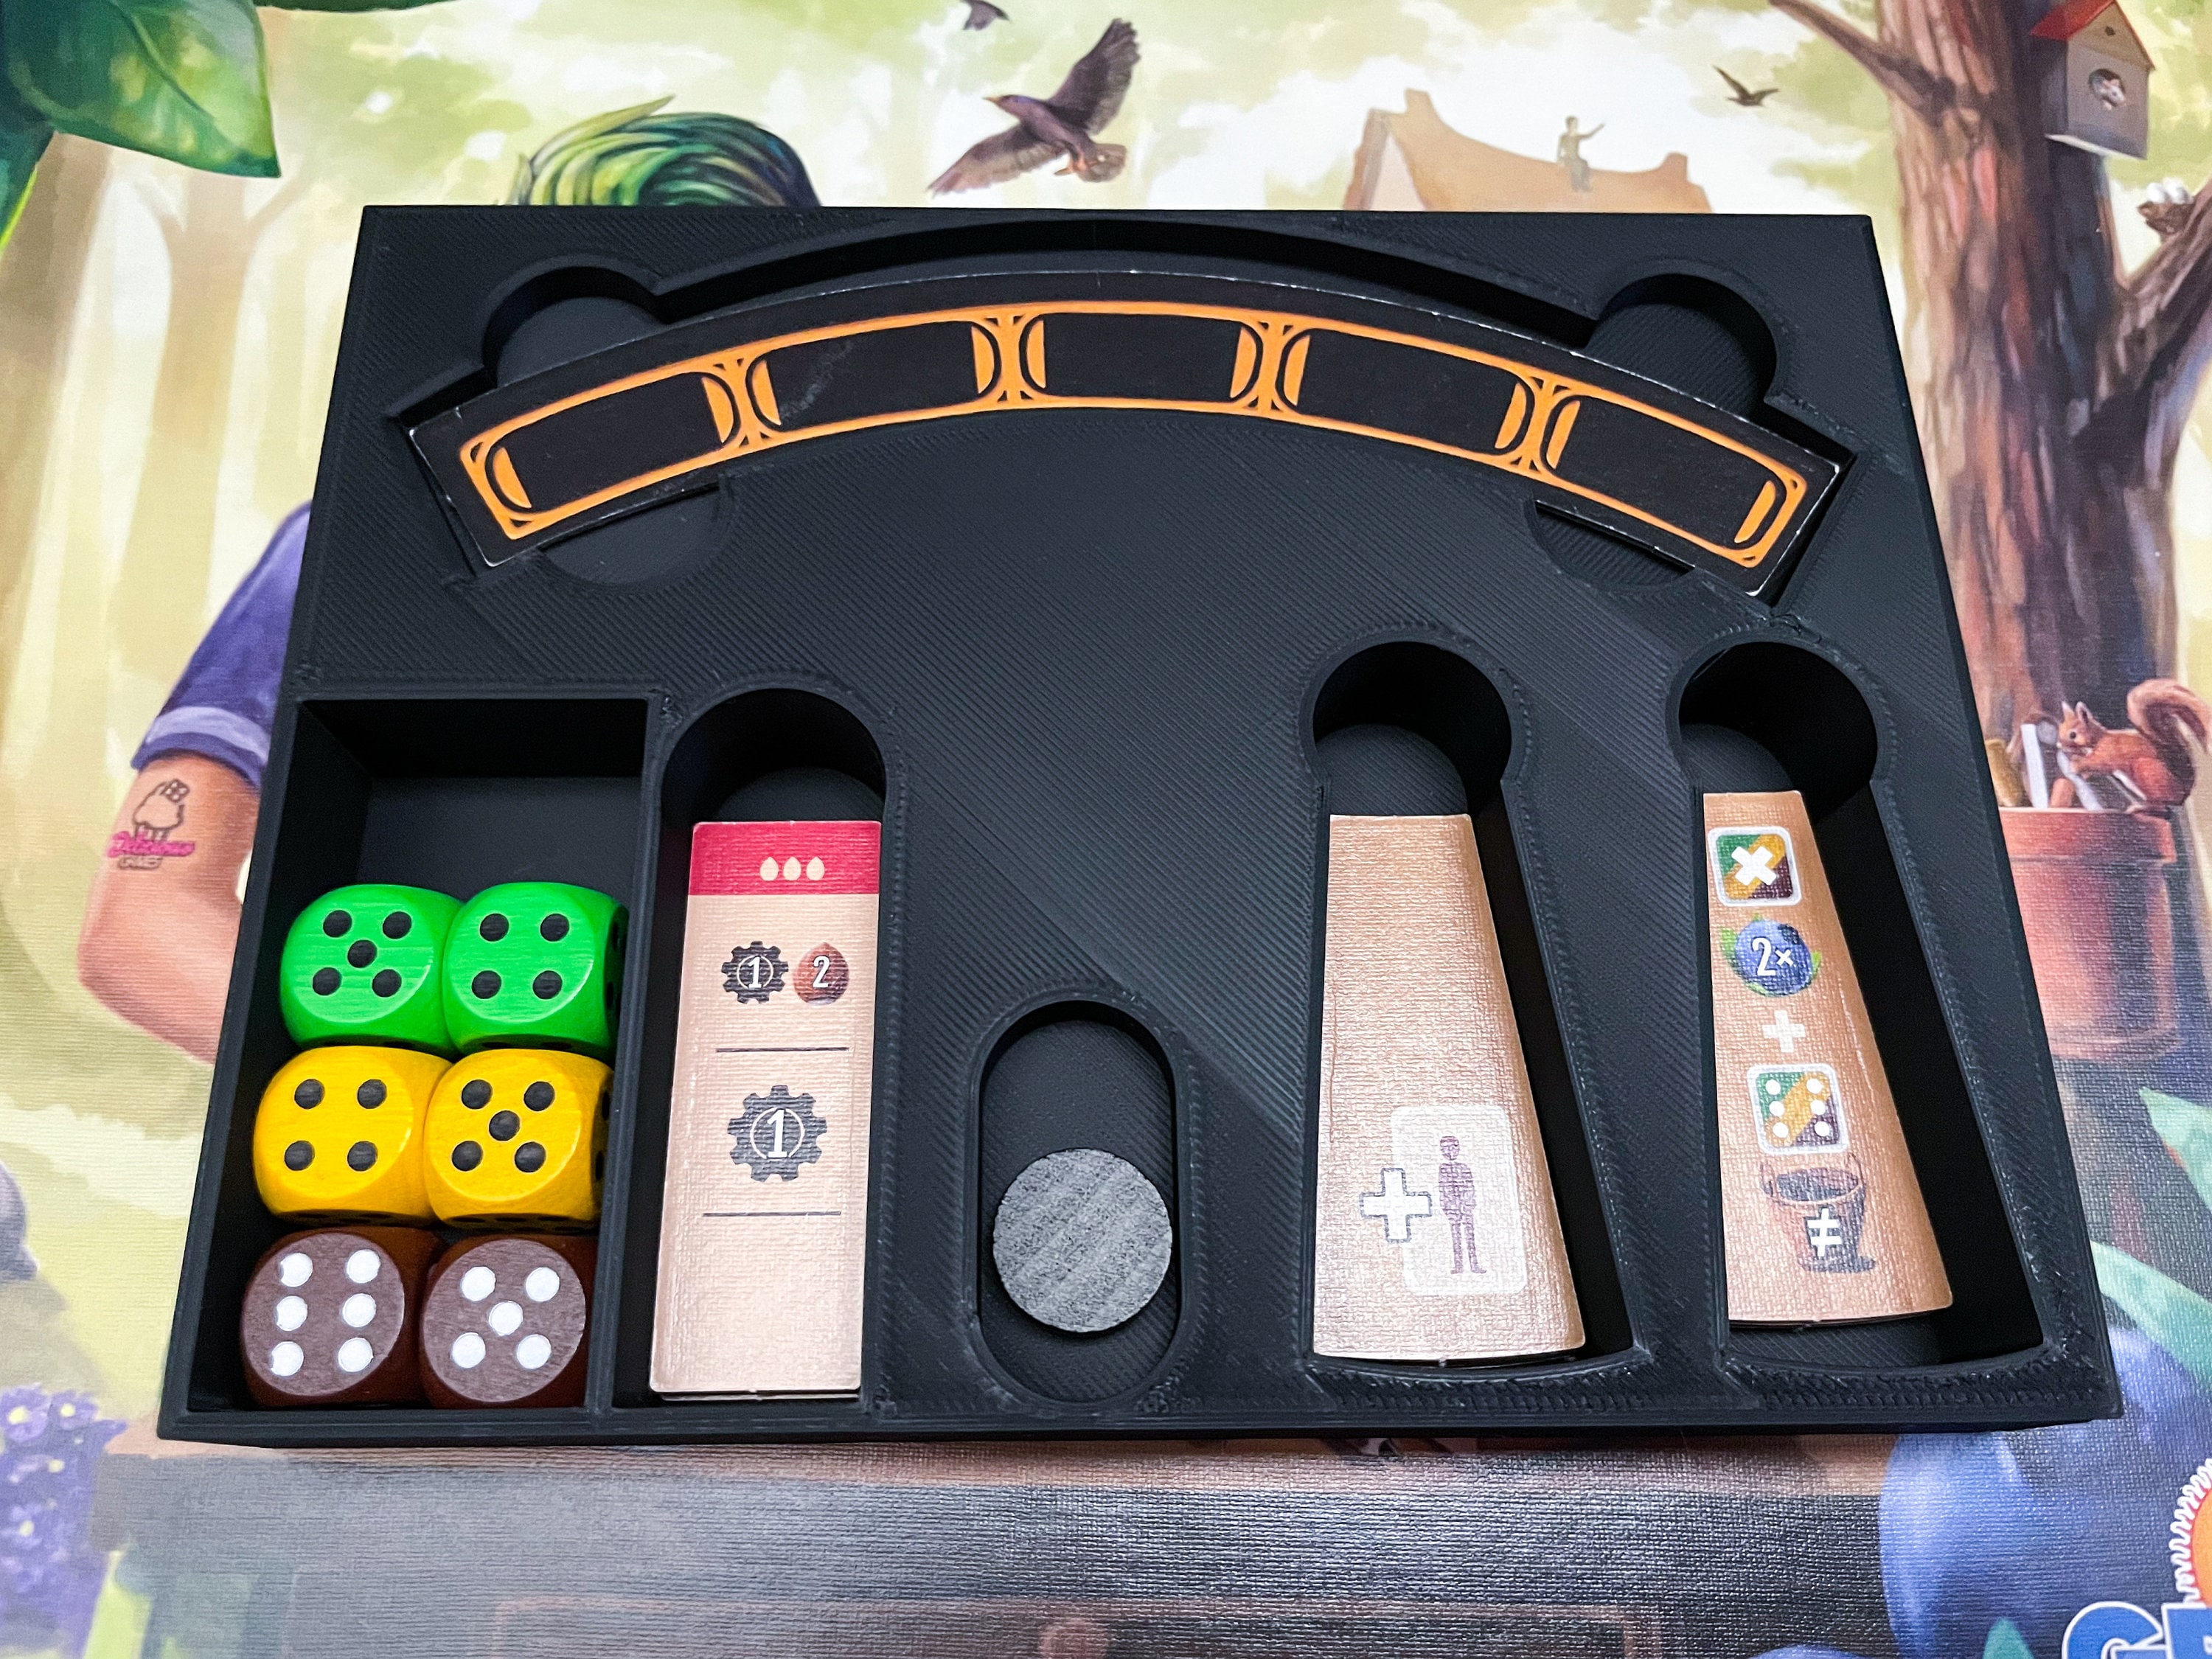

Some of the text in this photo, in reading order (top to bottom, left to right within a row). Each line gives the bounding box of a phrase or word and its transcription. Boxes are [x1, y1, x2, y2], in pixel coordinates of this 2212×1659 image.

[747, 956, 831, 989] 1 2
[767, 1107, 788, 1158] 1
